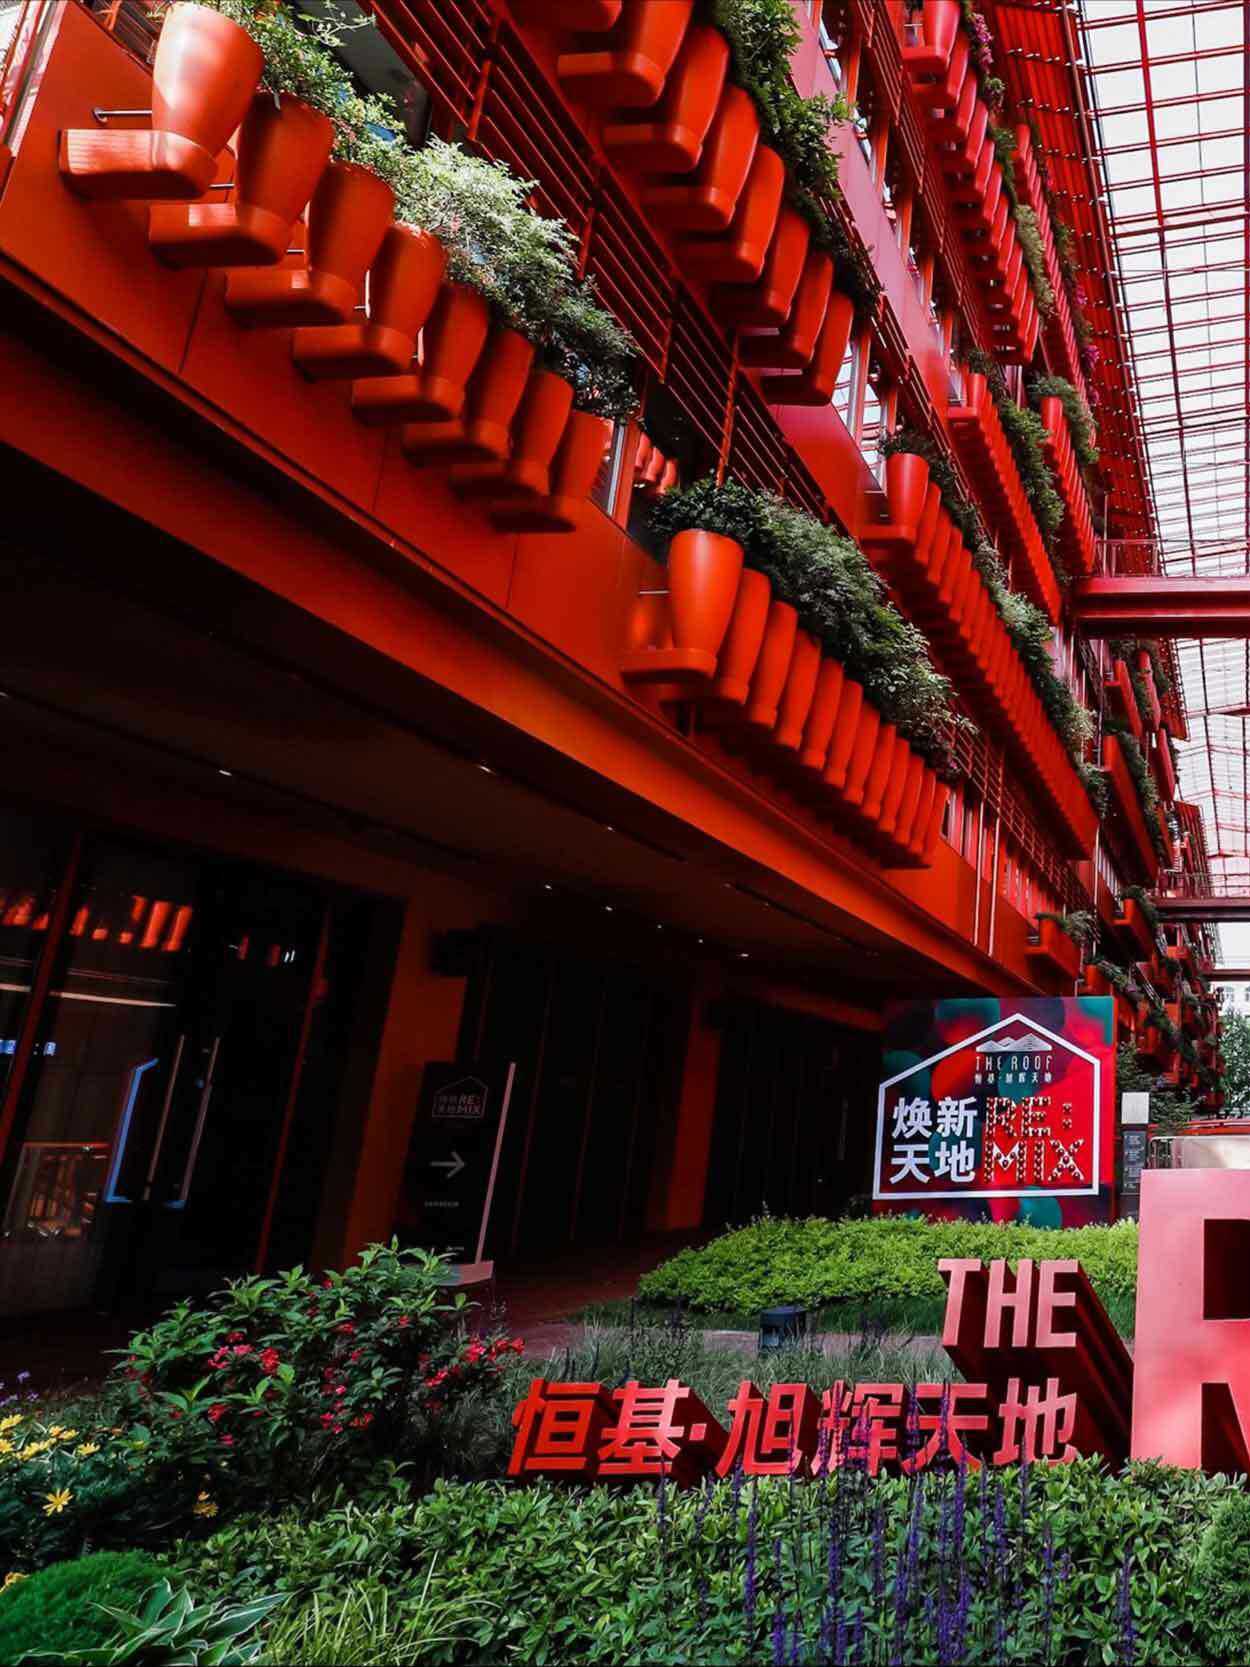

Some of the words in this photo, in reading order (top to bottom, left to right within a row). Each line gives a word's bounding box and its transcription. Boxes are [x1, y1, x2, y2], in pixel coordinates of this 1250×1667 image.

[975, 1055, 1002, 1071] THE
[1010, 1055, 1053, 1071] ROOF
[892, 1096, 978, 1139] 焕新
[889, 1140, 976, 1184] 天地
[984, 1138, 1085, 1184] MIX
[938, 1258, 1080, 1348] THE
